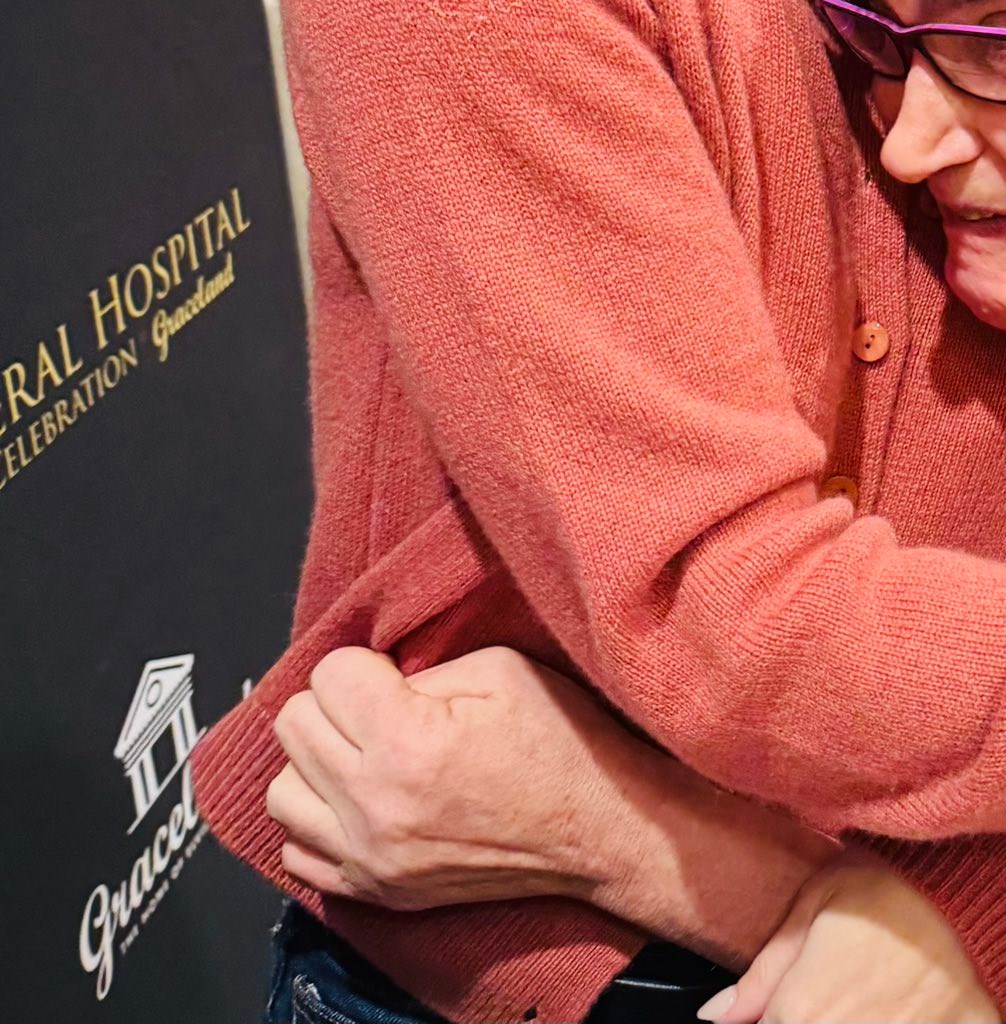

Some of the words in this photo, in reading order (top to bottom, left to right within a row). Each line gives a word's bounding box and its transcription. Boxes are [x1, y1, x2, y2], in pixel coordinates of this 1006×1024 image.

[0, 323, 84, 436] RAL
[88, 188, 251, 350] HOSPITAL
[0, 338, 138, 491] ELEBRATION
[152, 251, 236, 363] Graceland
